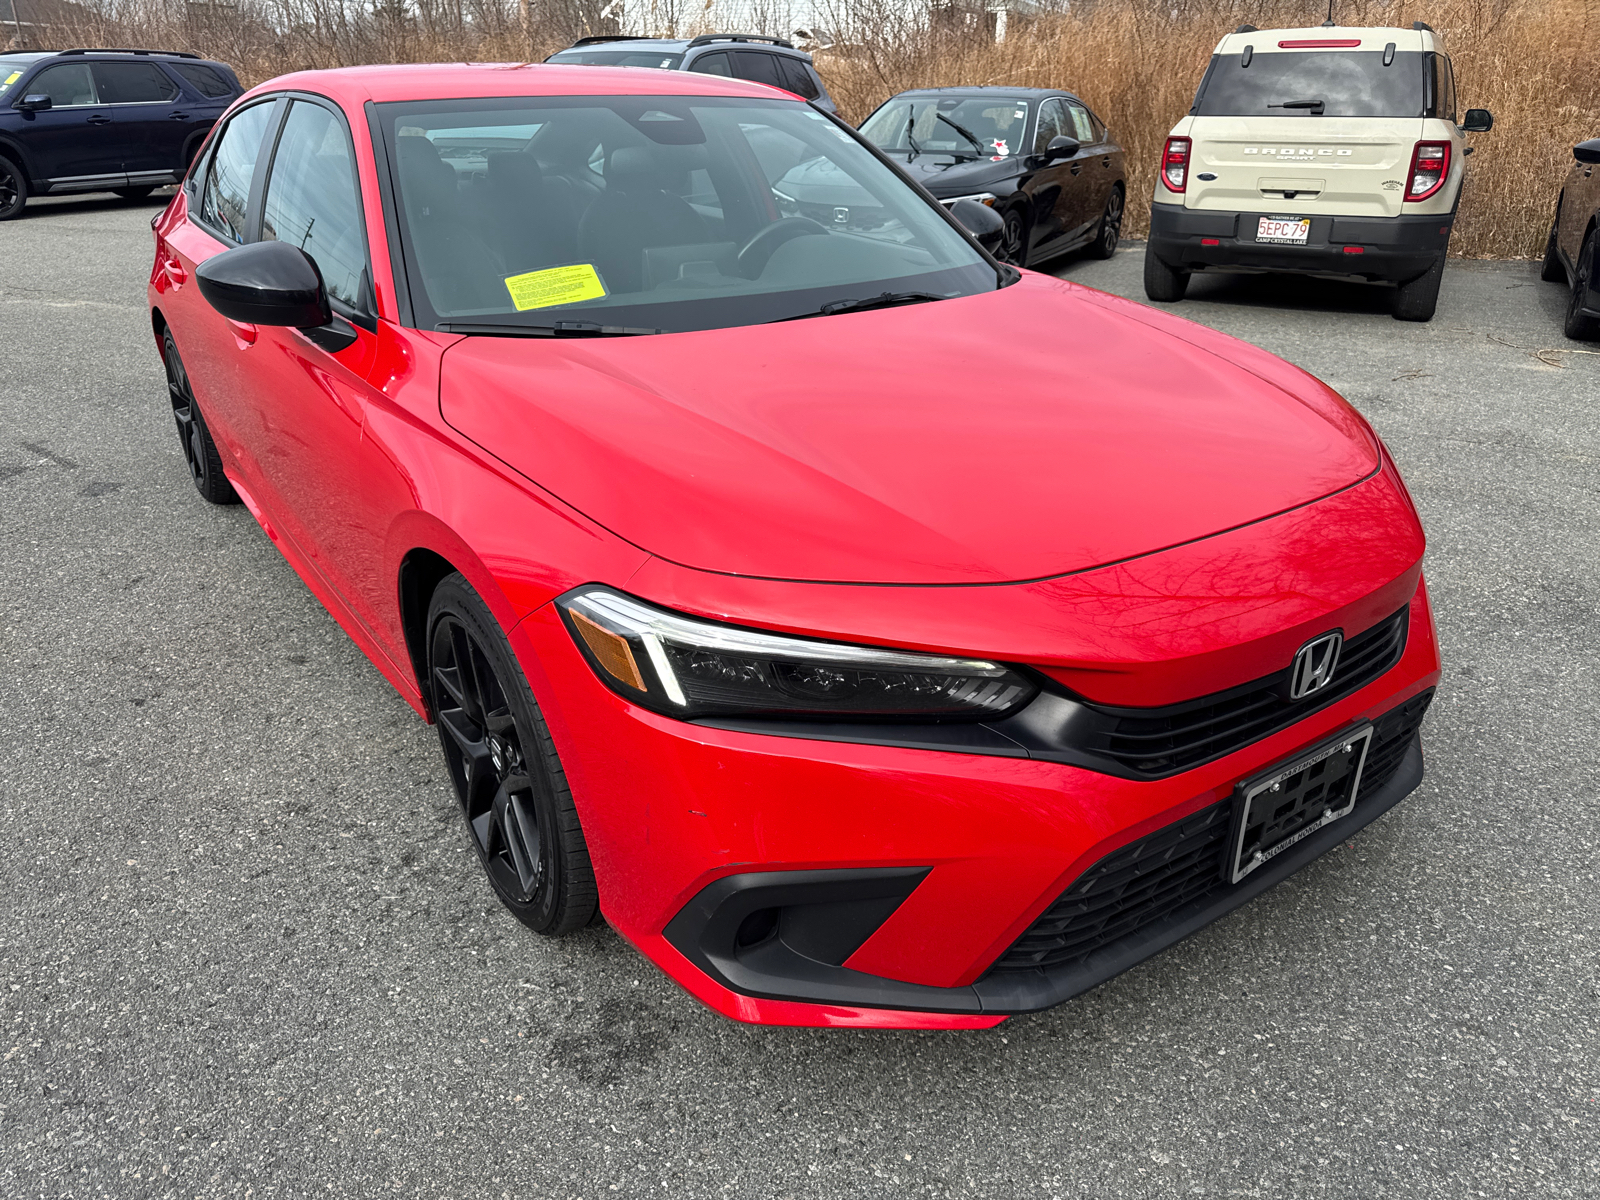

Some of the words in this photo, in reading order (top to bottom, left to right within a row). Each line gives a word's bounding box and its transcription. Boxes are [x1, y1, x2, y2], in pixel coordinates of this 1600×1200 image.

[1243, 147, 1353, 156] BRONCO
[1259, 221, 1289, 236] 5EPC
[1291, 223, 1308, 237] 79
[1280, 750, 1330, 780] DARTMOUTH
[1260, 836, 1296, 863] COLONIAL
[1297, 819, 1323, 841] HONDA
